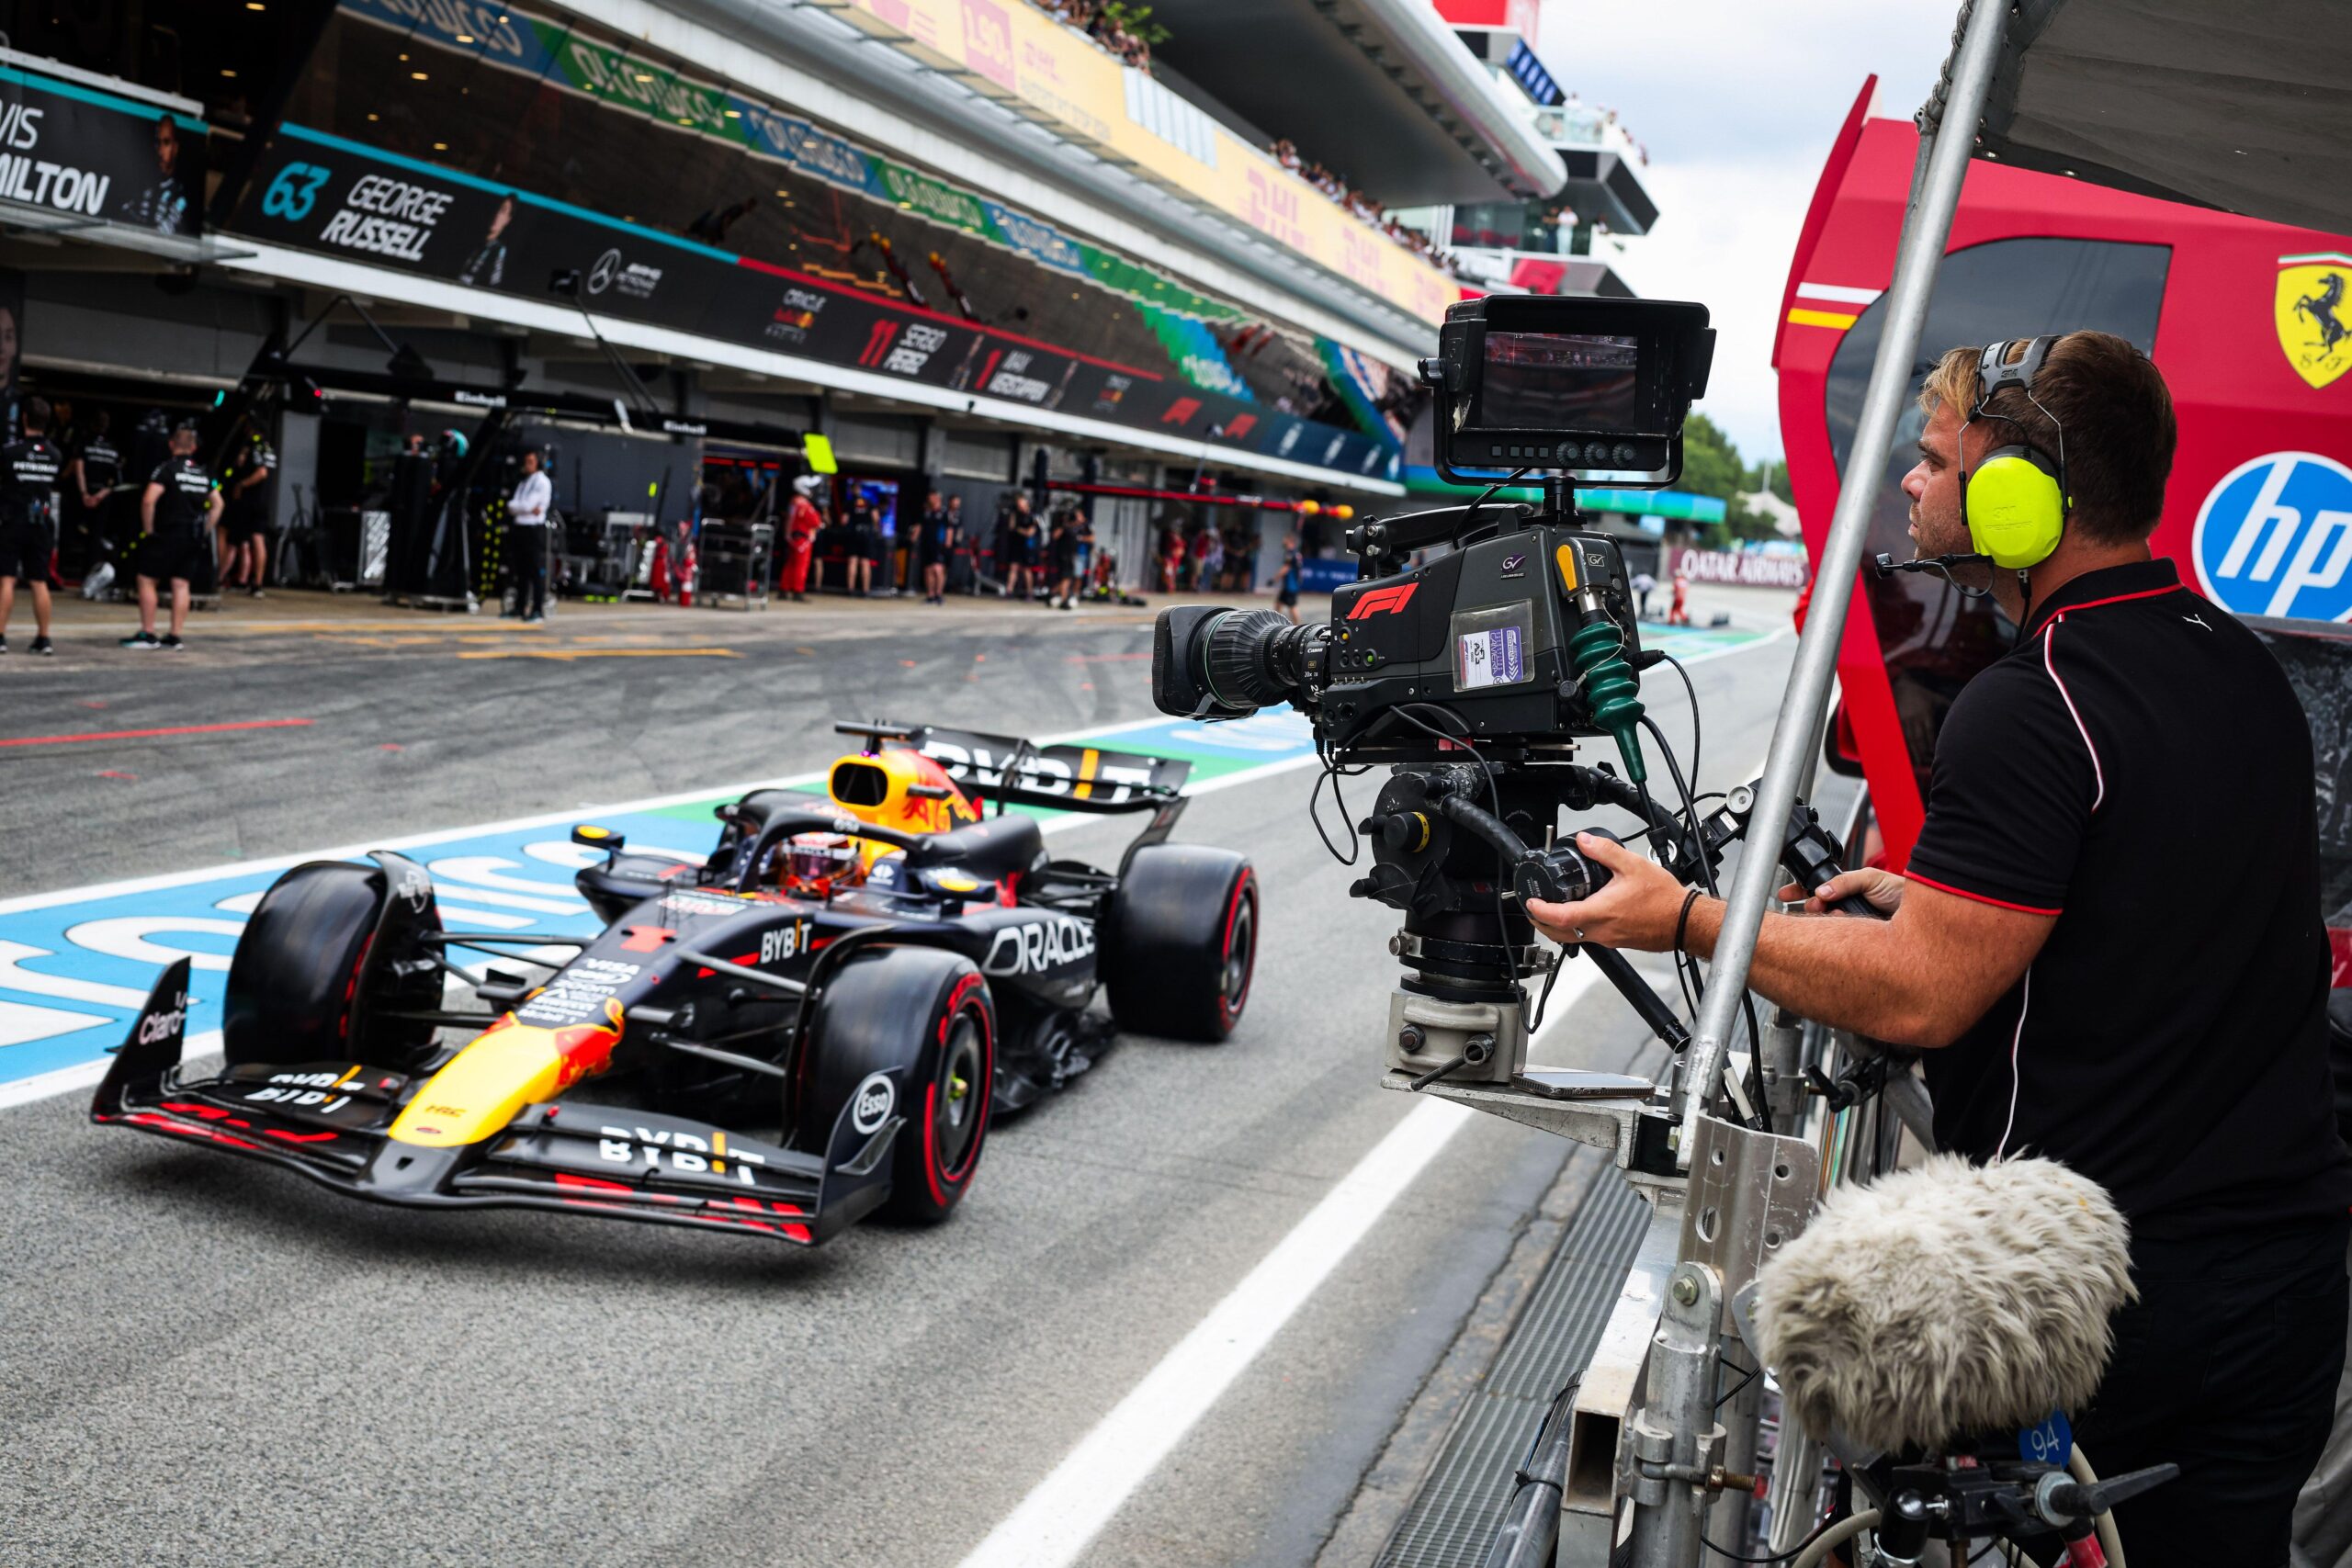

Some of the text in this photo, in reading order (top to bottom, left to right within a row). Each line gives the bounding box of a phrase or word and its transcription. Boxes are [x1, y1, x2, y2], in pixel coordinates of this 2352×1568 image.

[263, 161, 332, 220] 63
[346, 175, 454, 226] GEORGE
[319, 208, 431, 262] RUSSELL
[2215, 462, 2352, 620] hp
[1346, 581, 1419, 620] F1
[1490, 632, 1498, 675] CAMERA
[760, 917, 812, 964] BYBIT
[860, 1091, 888, 1118] Esso
[599, 1126, 765, 1186] BYBIT
[2031, 1420, 2059, 1461] 94
